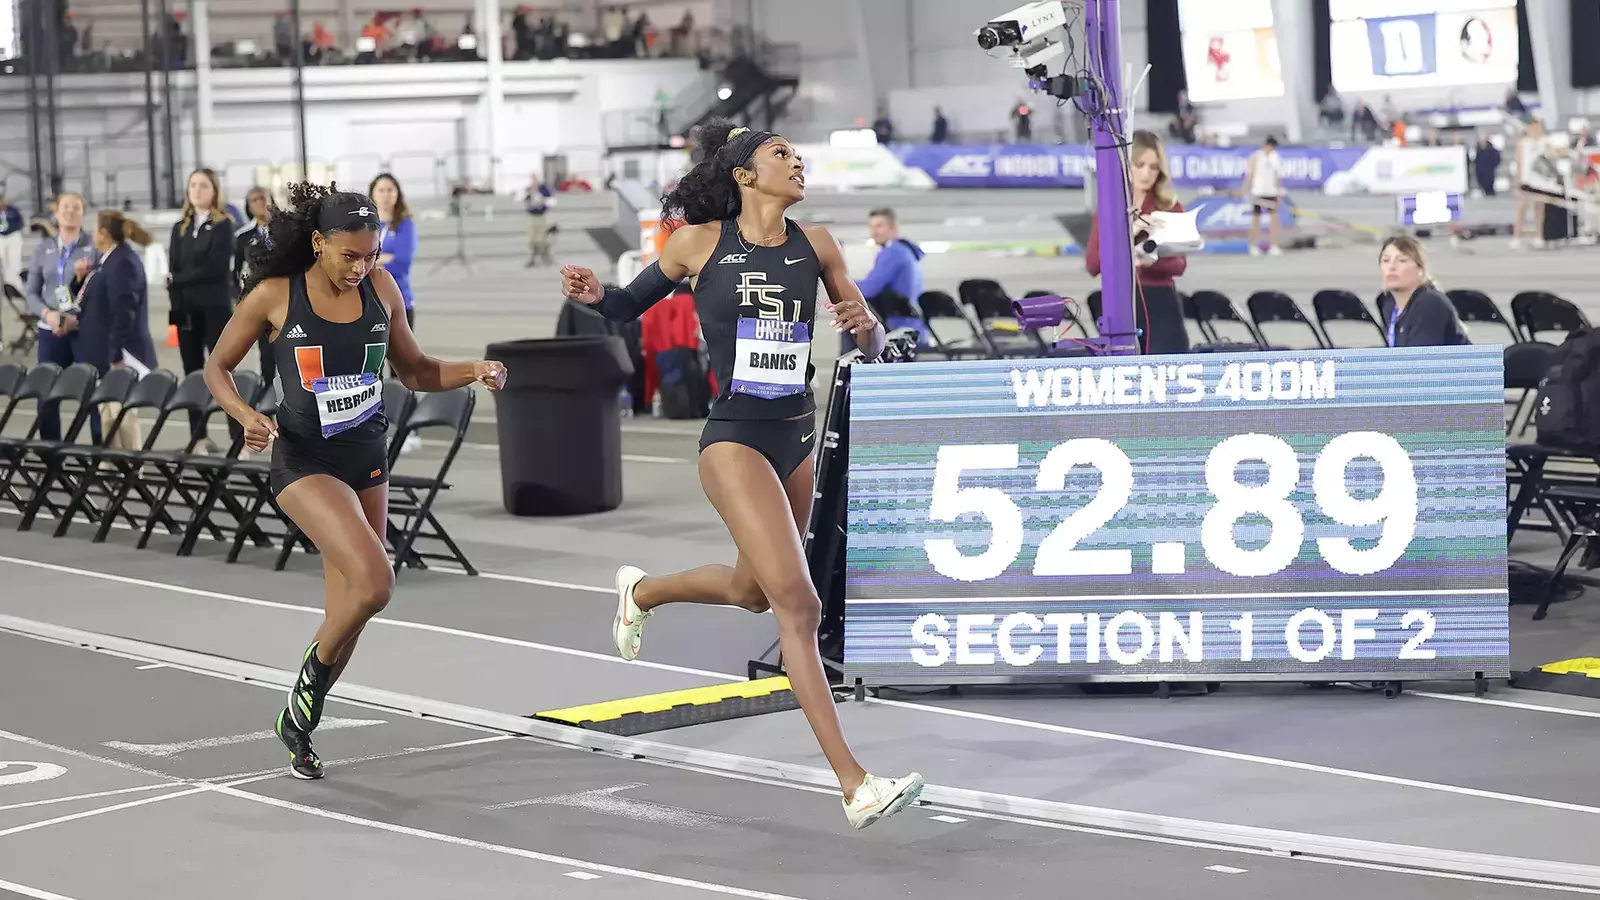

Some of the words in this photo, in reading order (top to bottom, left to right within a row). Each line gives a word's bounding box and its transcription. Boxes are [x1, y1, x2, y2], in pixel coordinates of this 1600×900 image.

[1031, 12, 1055, 27] LYNX
[937, 154, 991, 177] ACC
[717, 253, 748, 265] ACC
[286, 331, 307, 339] adidas
[370, 323, 386, 333] ACC
[755, 318, 795, 342] UNITE
[750, 351, 797, 371] BANKS
[1011, 363, 1205, 408] WOMEN'S
[1215, 360, 1337, 403] 400M
[326, 385, 376, 414] HEBRON
[923, 431, 1418, 582] 52.89
[909, 609, 1203, 668] SECTION
[1229, 610, 1253, 662] 1
[1284, 607, 1379, 663] OF
[1399, 608, 1437, 661] 2
